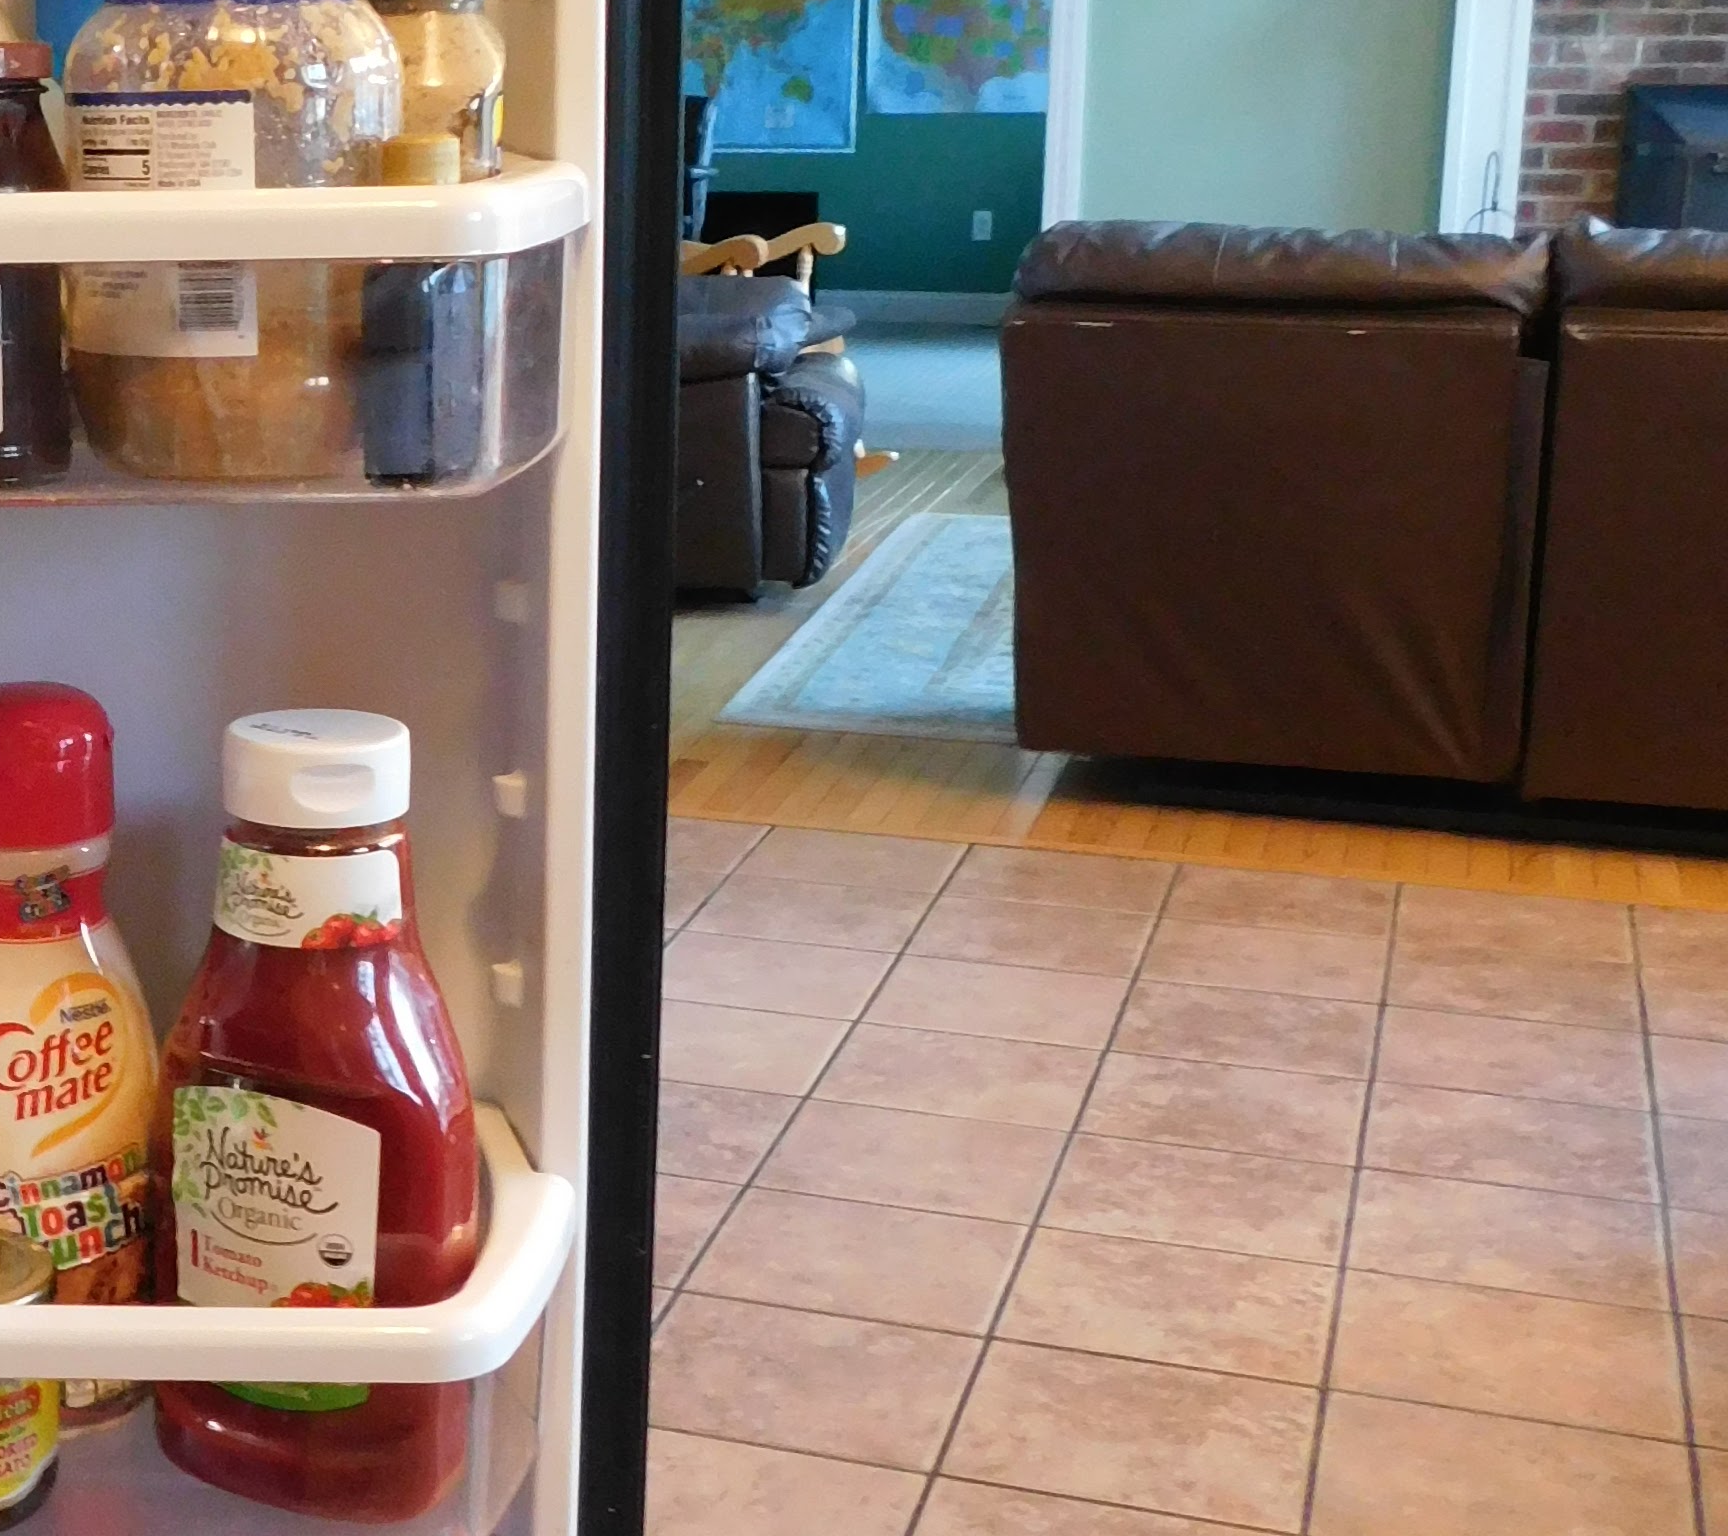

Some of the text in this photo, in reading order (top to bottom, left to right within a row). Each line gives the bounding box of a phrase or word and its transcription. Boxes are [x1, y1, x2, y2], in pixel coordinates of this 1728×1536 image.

[141, 158, 151, 176] 5
[14, 1061, 114, 1122] mate
[205, 1126, 323, 1186] Nature's
[199, 1160, 340, 1215] Promise
[217, 1195, 303, 1232] Organic
